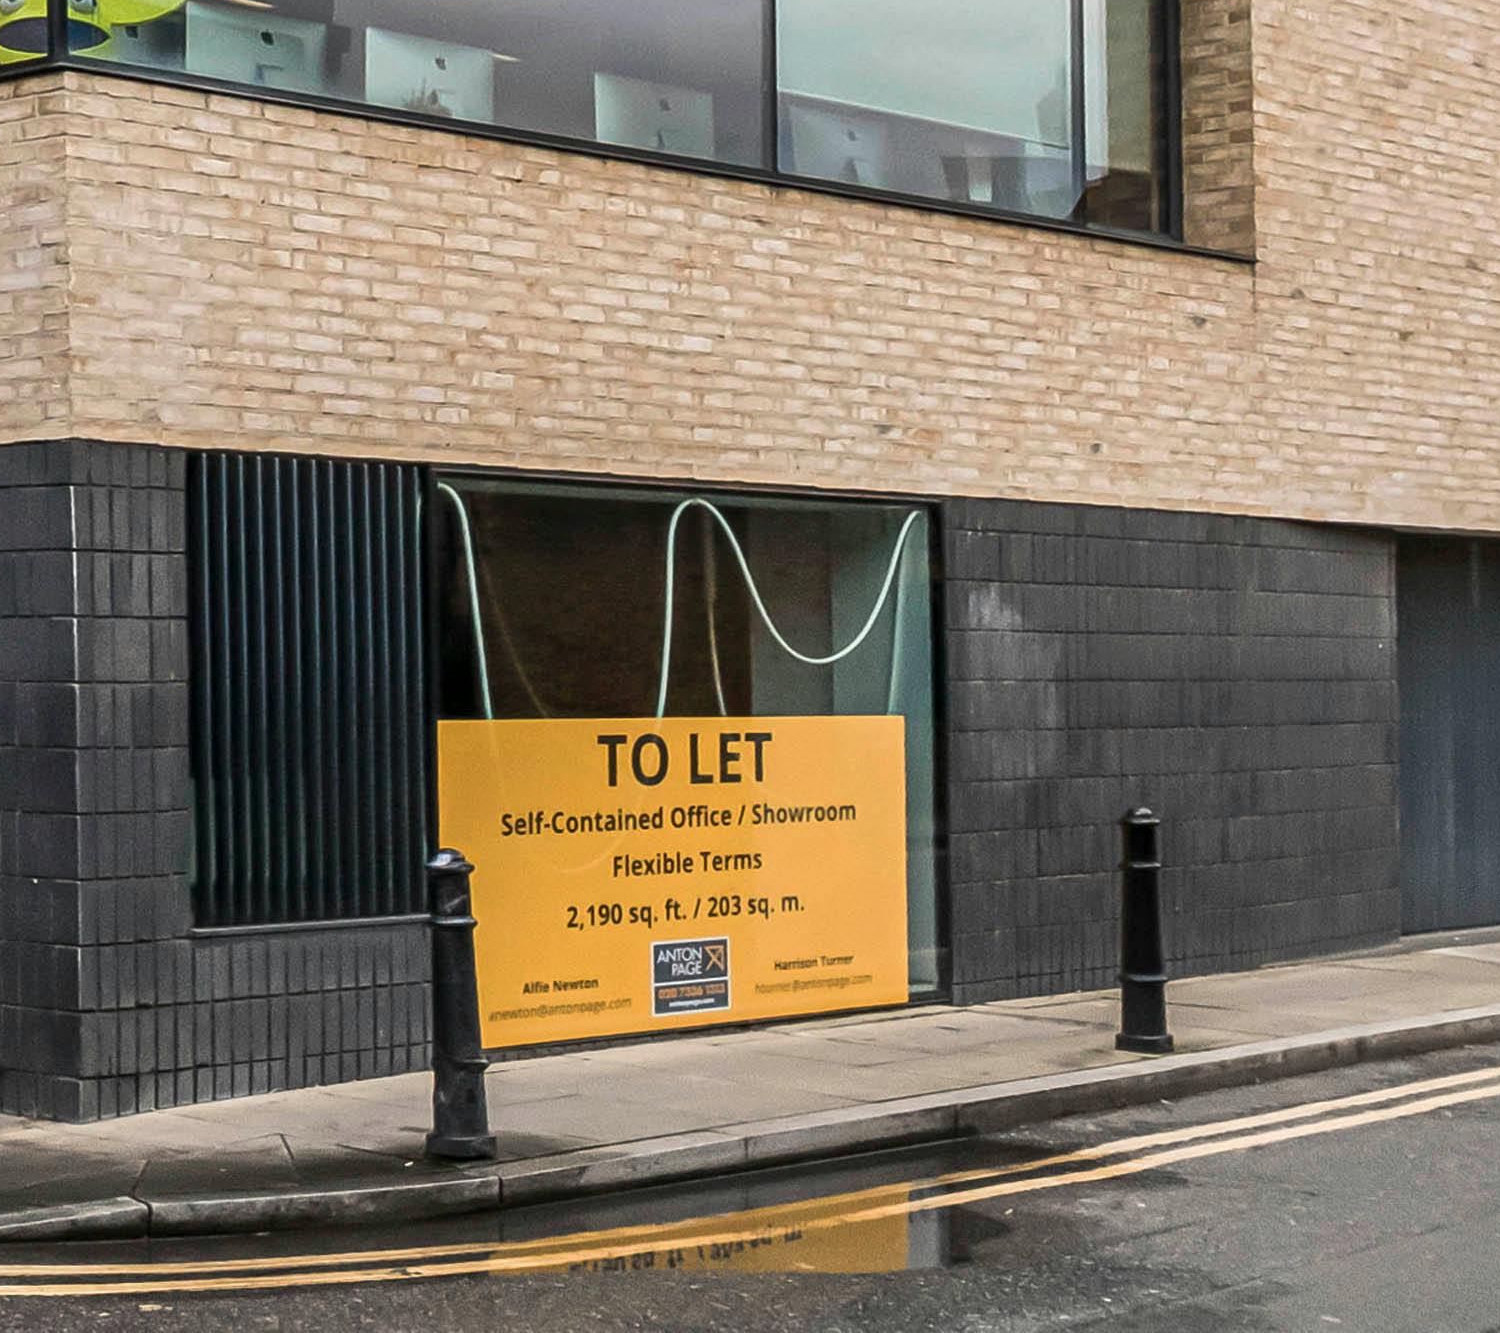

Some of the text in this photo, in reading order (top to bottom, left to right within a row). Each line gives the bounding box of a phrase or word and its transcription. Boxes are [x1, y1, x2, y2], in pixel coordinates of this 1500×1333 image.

[596, 731, 773, 788] TO LET
[500, 802, 857, 837] Self-Contained Office / Showroom
[612, 850, 763, 878] Flexible Terms
[566, 894, 806, 931] 2,190 sq. ft. / 203 sq. m.
[656, 945, 703, 965] ANTON
[671, 960, 704, 977] PAGE
[522, 978, 600, 994] Alfie Newton
